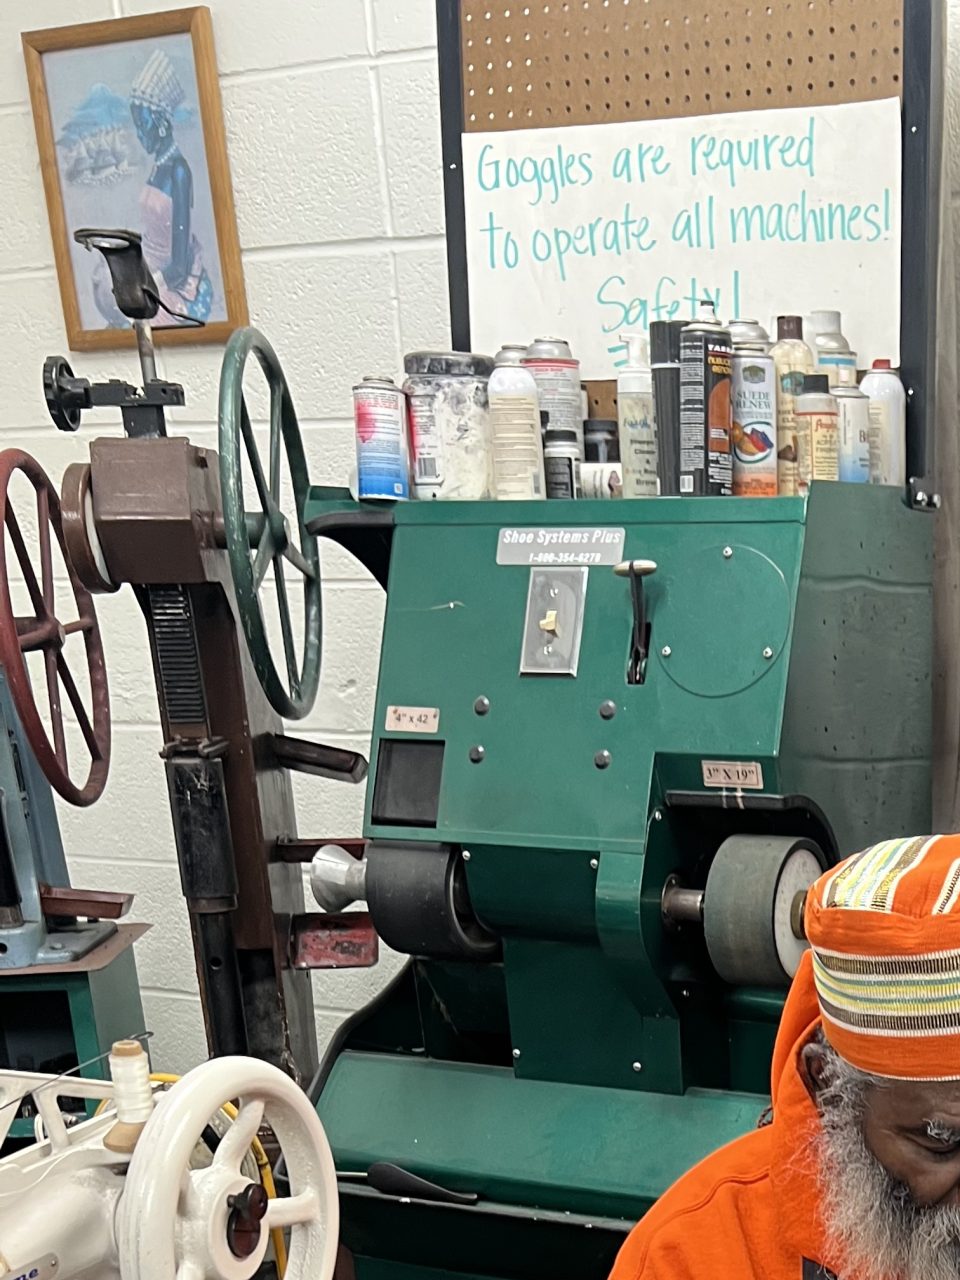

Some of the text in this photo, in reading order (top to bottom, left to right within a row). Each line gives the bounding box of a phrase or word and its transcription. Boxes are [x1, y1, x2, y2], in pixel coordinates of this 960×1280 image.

[478, 116, 815, 206] Goggles are required
[480, 188, 890, 281] to operate all machines!
[736, 400, 772, 409] RENEW
[503, 530, 621, 546] Shoe Systems Plus
[529, 552, 602, 563] 1-800-354-6278
